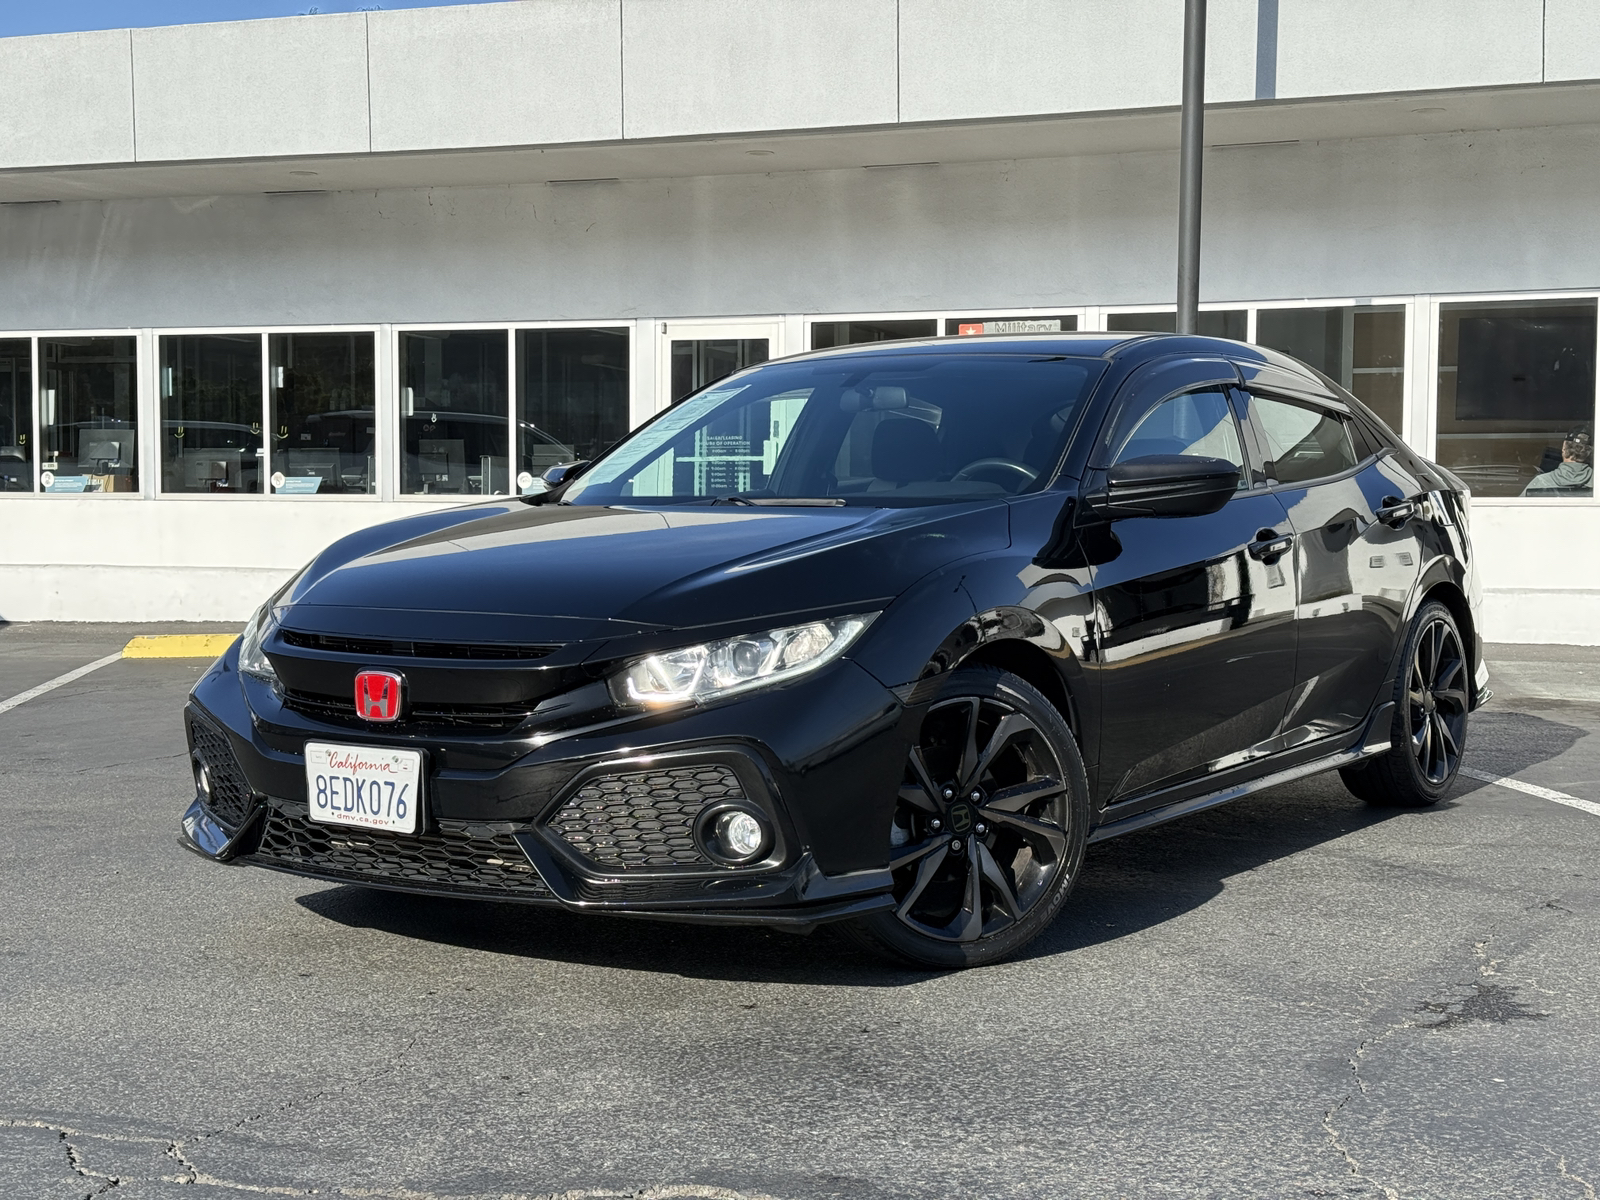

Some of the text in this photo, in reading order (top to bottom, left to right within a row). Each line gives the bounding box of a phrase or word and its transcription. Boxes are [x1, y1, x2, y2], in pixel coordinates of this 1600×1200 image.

[994, 321, 1052, 333] Military
[329, 751, 398, 775] California
[316, 774, 409, 819] 8EDK076
[336, 812, 390, 826] dmv.ca.gov
